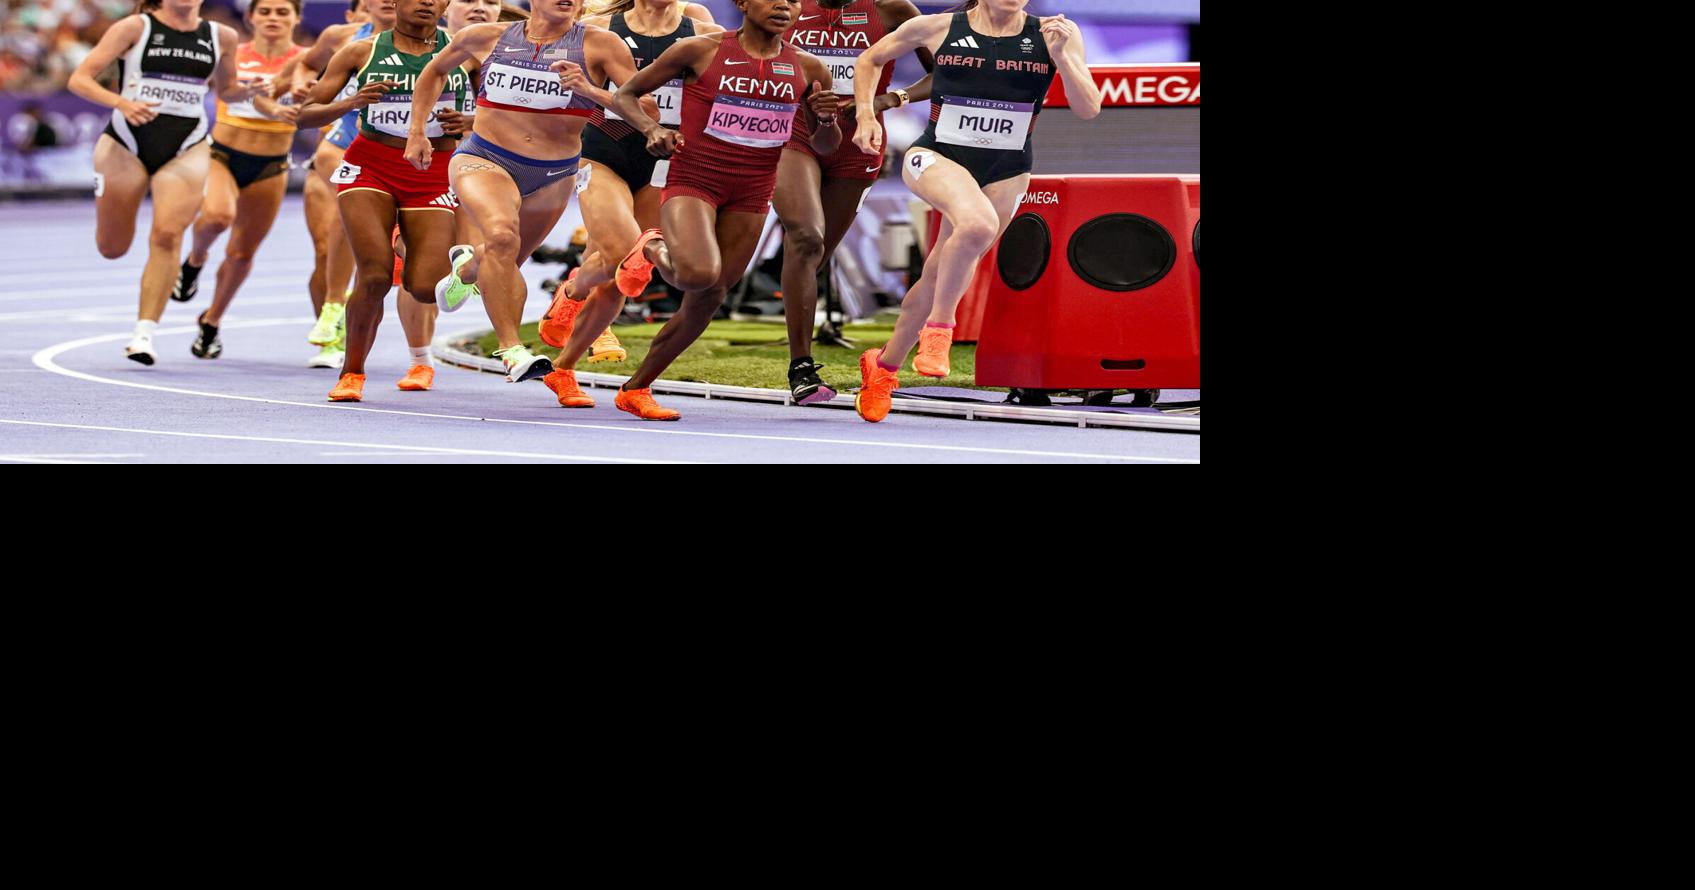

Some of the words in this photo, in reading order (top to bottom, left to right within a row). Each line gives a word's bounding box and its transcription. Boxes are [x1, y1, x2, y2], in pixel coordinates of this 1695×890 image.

[789, 29, 871, 48] KENYA
[148, 48, 172, 57] NEW
[172, 48, 213, 64] ZEALAND
[936, 54, 986, 69] GREAT
[995, 59, 1049, 75] BRITAIN
[487, 71, 506, 88] ST.
[718, 74, 795, 100] KENYA
[740, 100, 763, 108] PARIS
[711, 111, 789, 134] KIPYEGON
[958, 114, 1014, 135] MUIR
[911, 154, 922, 169] 9
